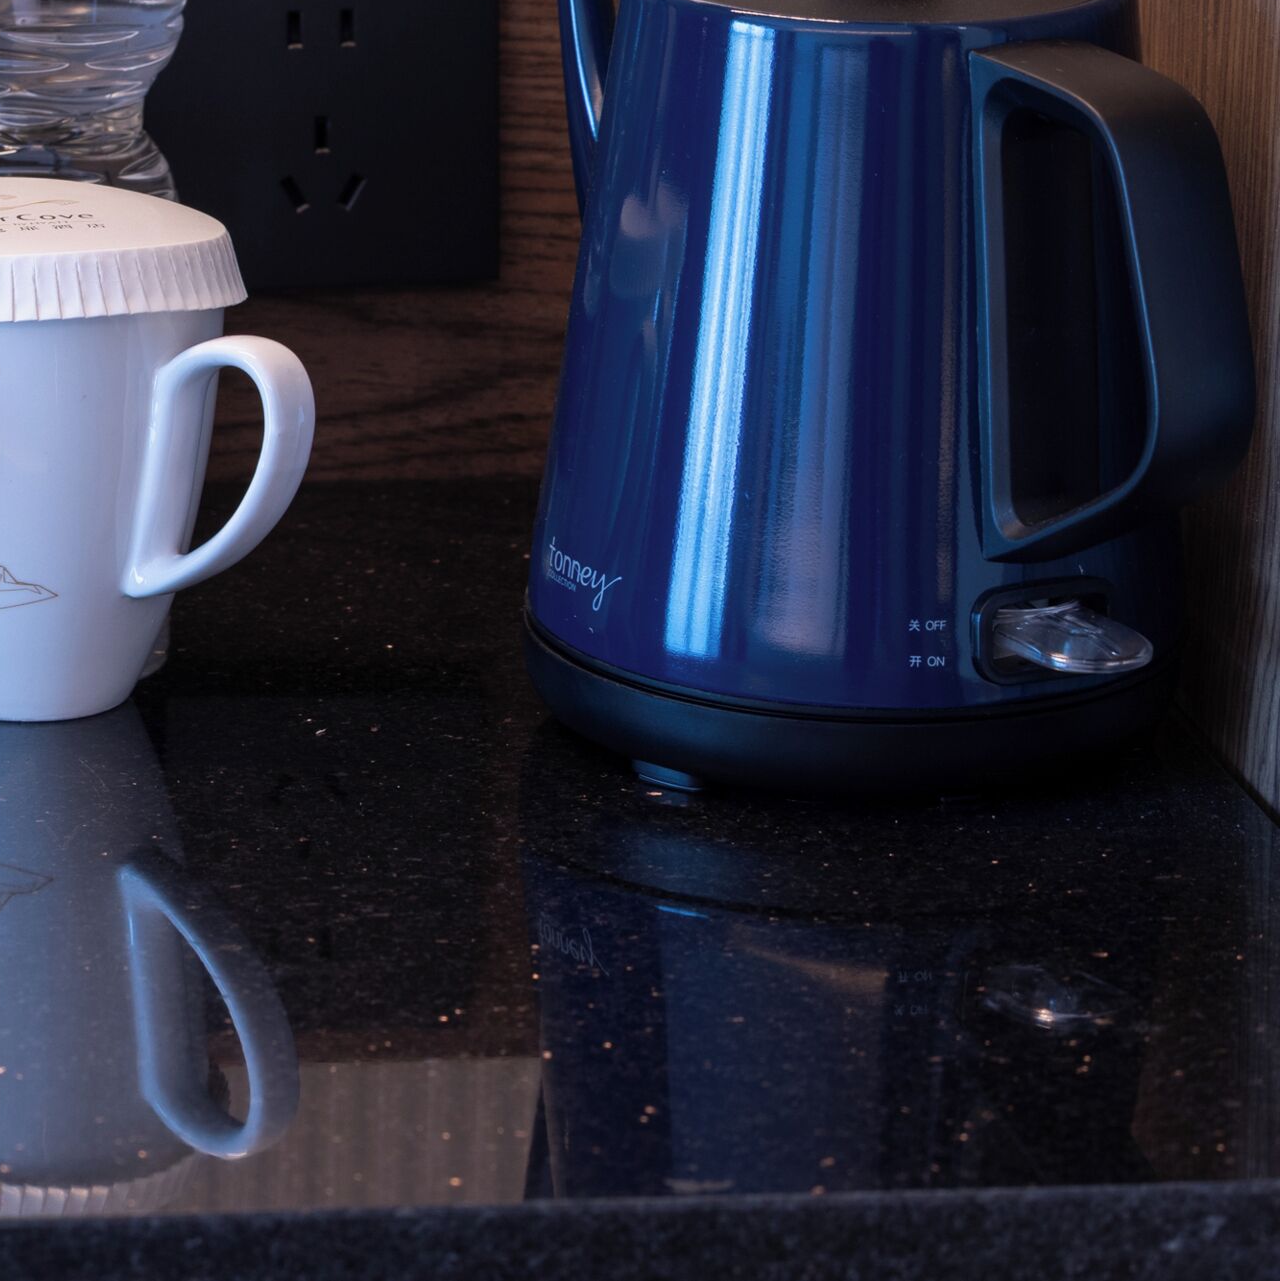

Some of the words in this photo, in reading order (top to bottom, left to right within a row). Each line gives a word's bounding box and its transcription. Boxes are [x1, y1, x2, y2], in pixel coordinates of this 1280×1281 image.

[549, 536, 622, 611] tonney
[909, 619, 921, 631] 关
[925, 619, 947, 631] OFF
[909, 655, 922, 668] 开
[927, 655, 945, 667] ON
